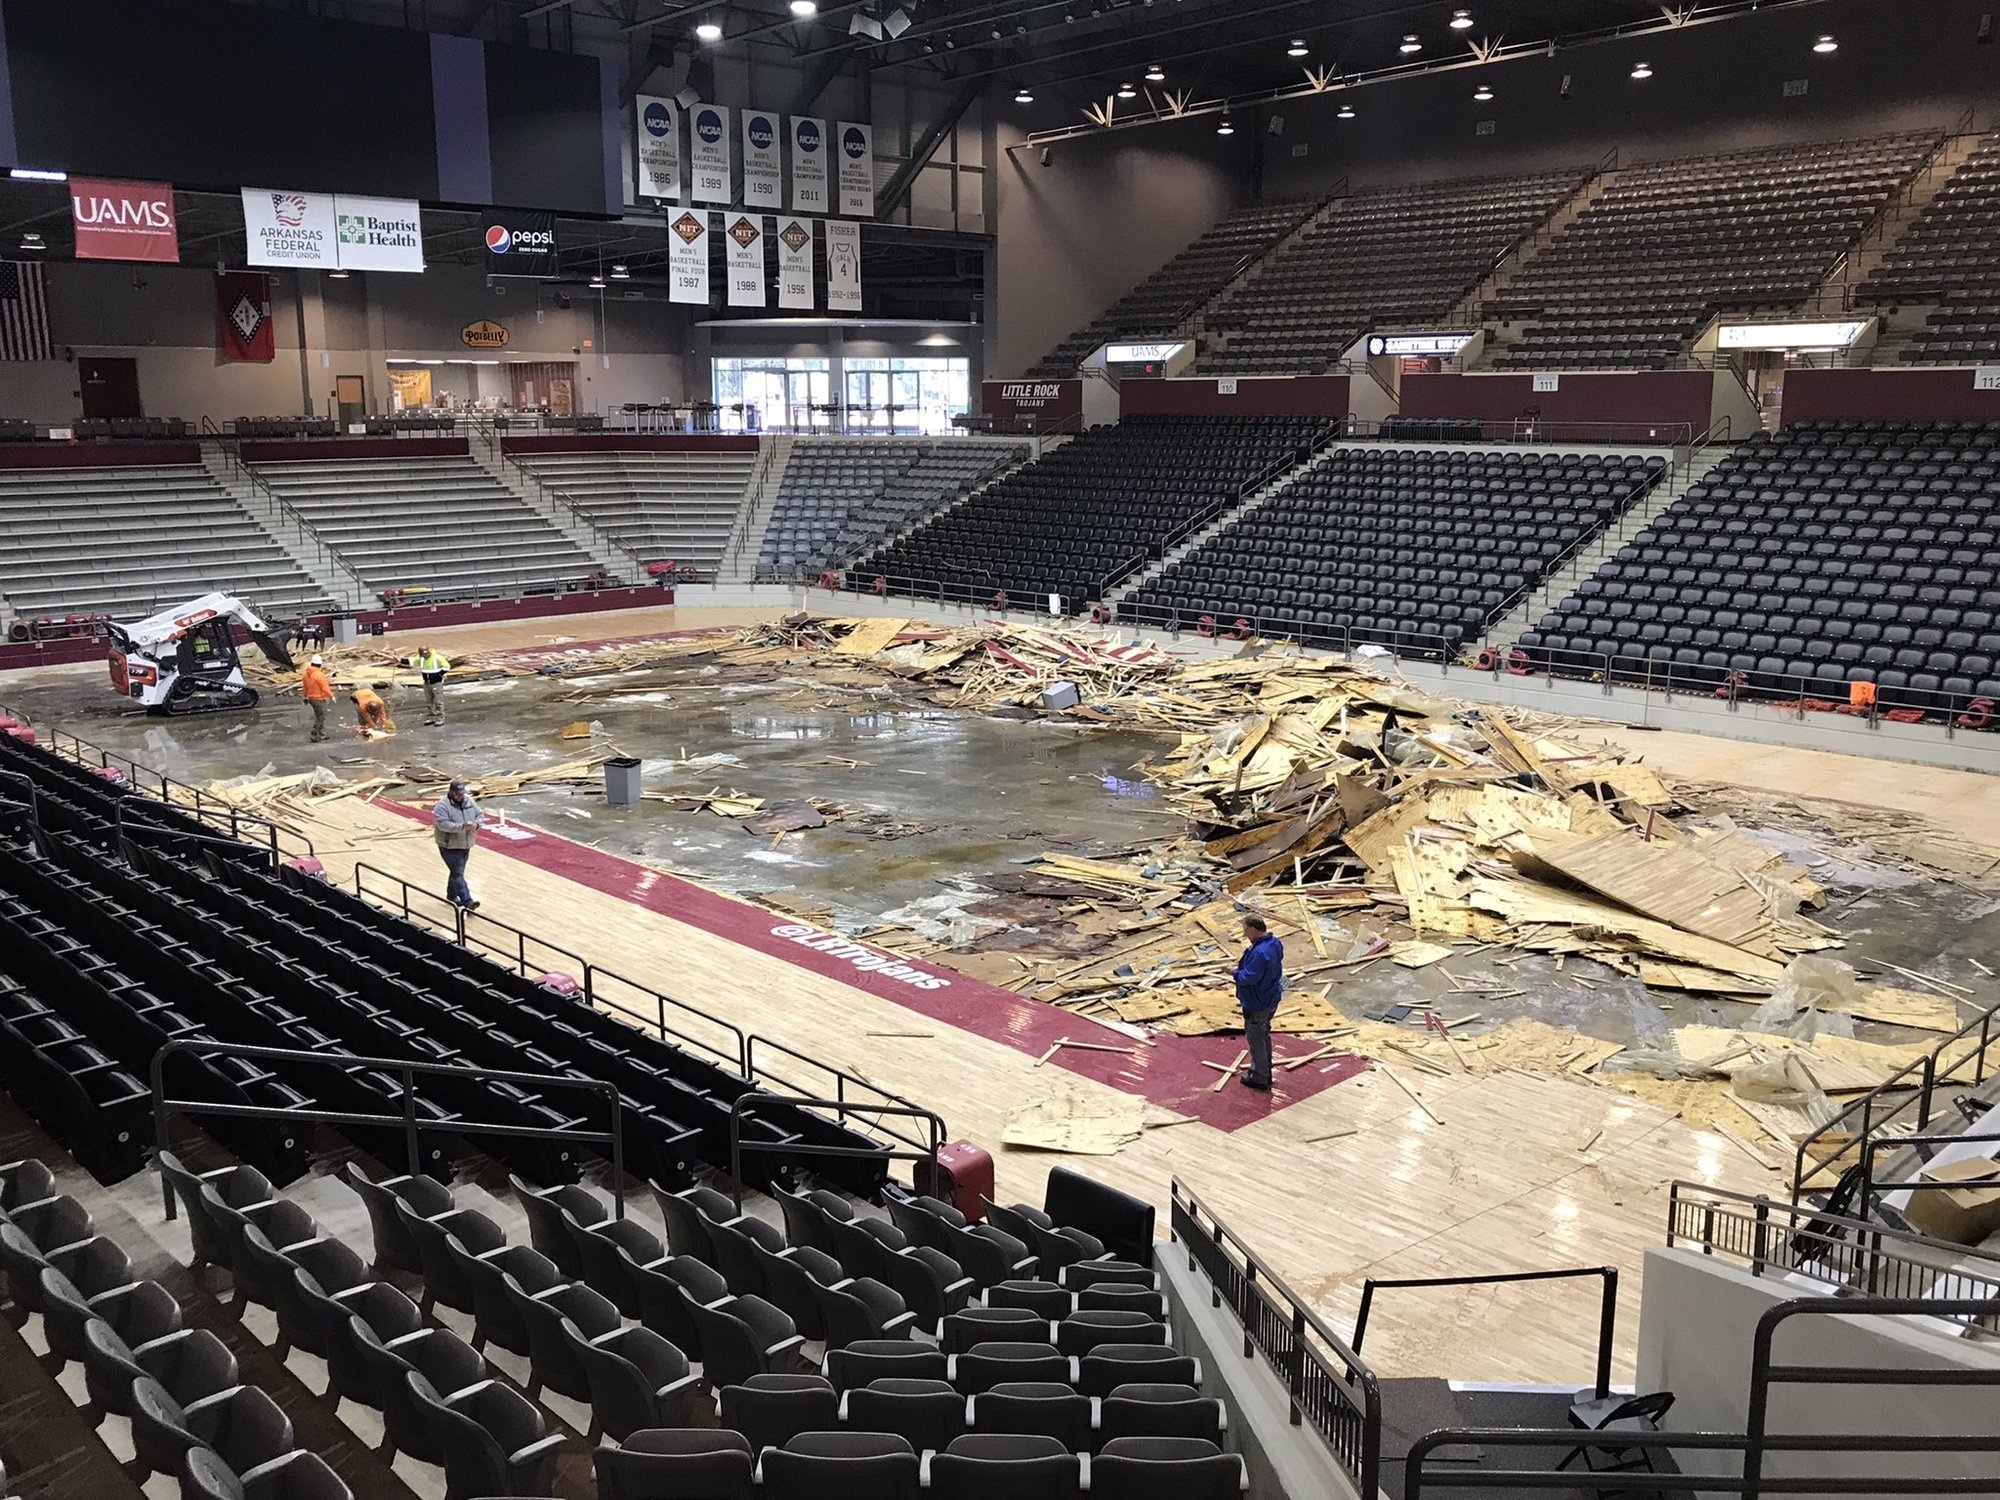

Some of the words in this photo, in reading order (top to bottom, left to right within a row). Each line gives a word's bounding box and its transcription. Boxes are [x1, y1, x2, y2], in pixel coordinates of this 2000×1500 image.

[646, 118, 670, 129] NCAA
[699, 125, 721, 136] NCAA
[751, 132, 772, 142] NCAA
[799, 135, 819, 145] NCAA
[845, 142, 866, 151] NCAA
[649, 172, 671, 184] 1986
[701, 177, 721, 189] 1989
[753, 183, 773, 194] 1990
[801, 190, 819, 200] 2011
[850, 198, 863, 207] 2016
[73, 196, 170, 227] UAMS
[368, 217, 417, 233] Baptist
[679, 224, 698, 233] NIT
[260, 227, 323, 241] ARKANSAS
[735, 229, 754, 237] NIT
[830, 226, 856, 236] FISHER
[369, 233, 416, 247] Health
[512, 229, 555, 247] pepsi
[787, 233, 803, 241] NIT
[266, 239, 320, 252] FEDERAL
[267, 250, 294, 259] CREDIT
[296, 251, 321, 260] UNION
[841, 263, 847, 276] 4
[679, 277, 699, 288] 1987
[736, 280, 756, 291] 1988
[787, 284, 805, 295] 1996
[465, 330, 504, 343] POTBELLY
[1132, 345, 1159, 358] UAMS
[1540, 381, 1553, 390] 111
[1982, 377, 2000, 388] 112
[1002, 384, 1031, 397] LITTLE
[1033, 384, 1060, 396] ROCK
[1016, 399, 1045, 407] TROJANS
[770, 925, 951, 990] @LRTrojans
